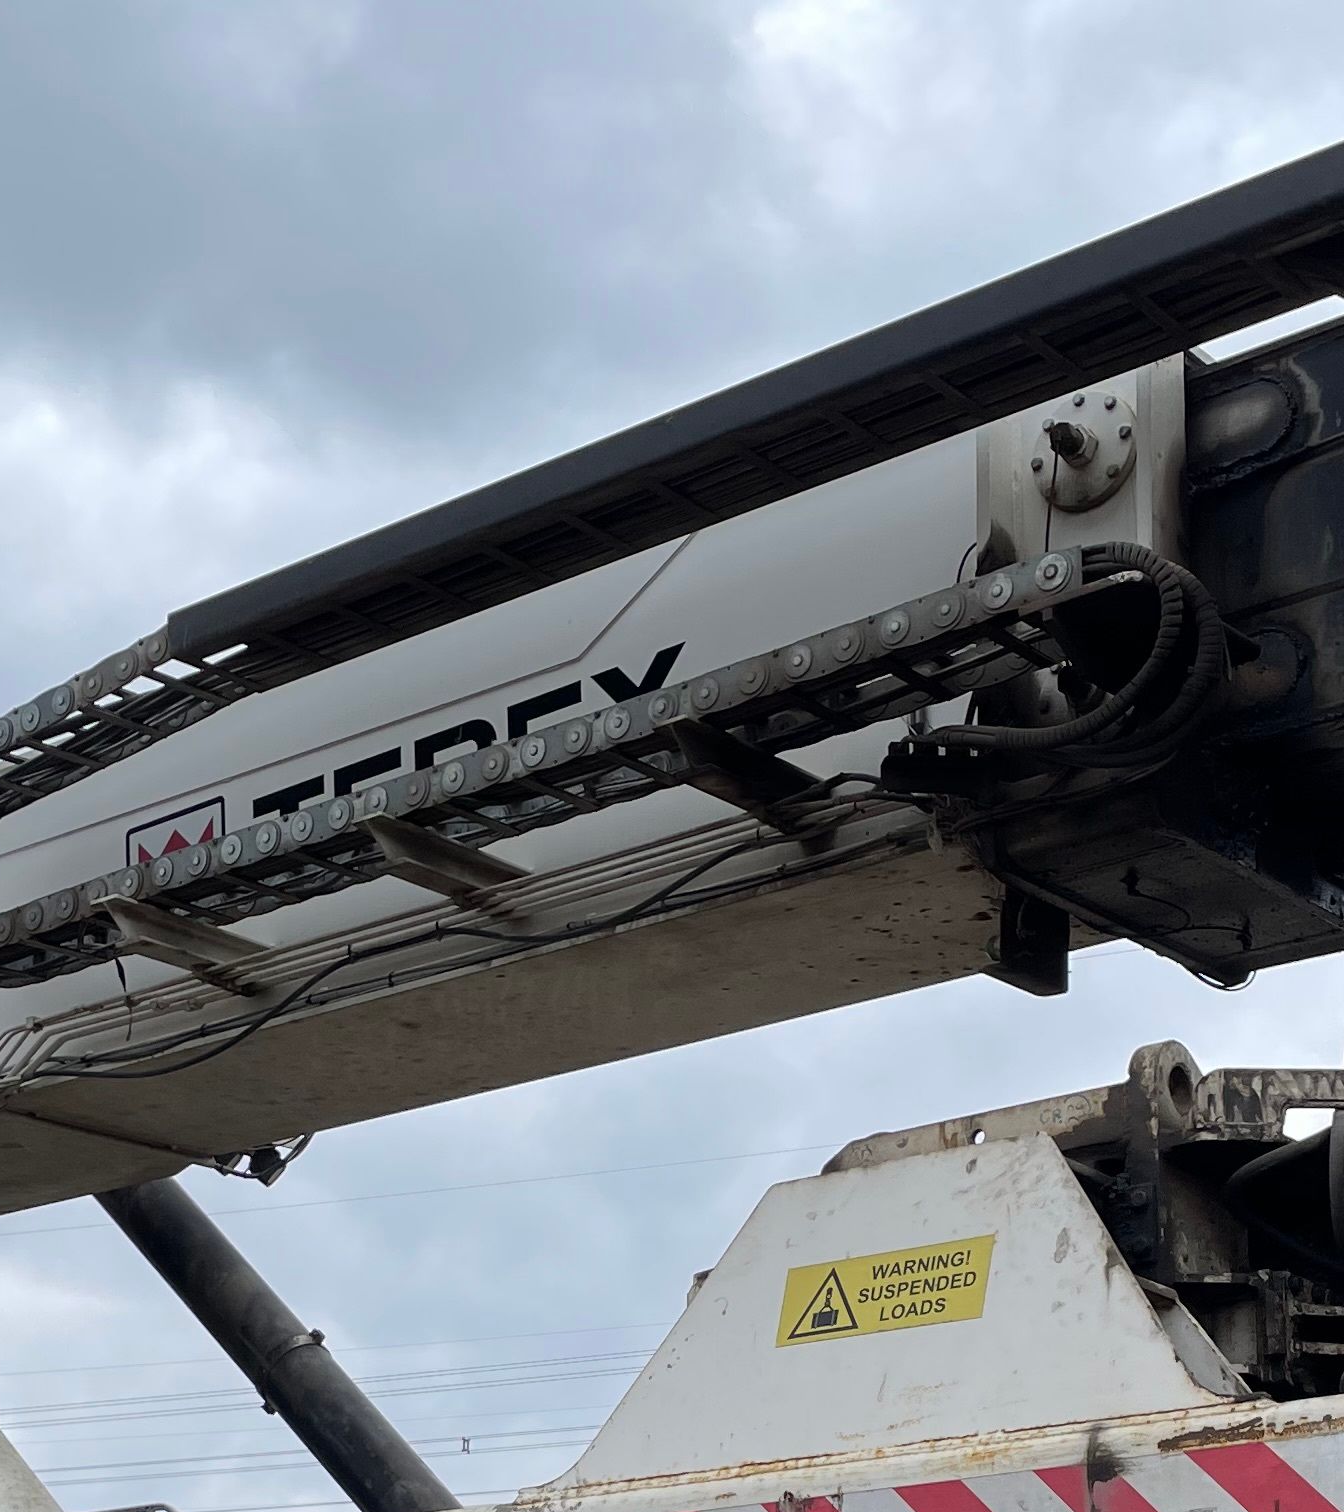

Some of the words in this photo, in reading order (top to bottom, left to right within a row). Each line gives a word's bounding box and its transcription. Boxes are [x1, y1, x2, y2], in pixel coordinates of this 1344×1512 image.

[871, 1249, 971, 1280] WARNING!
[857, 1271, 977, 1303] SUSPENDED
[879, 1297, 947, 1322] LOADS
